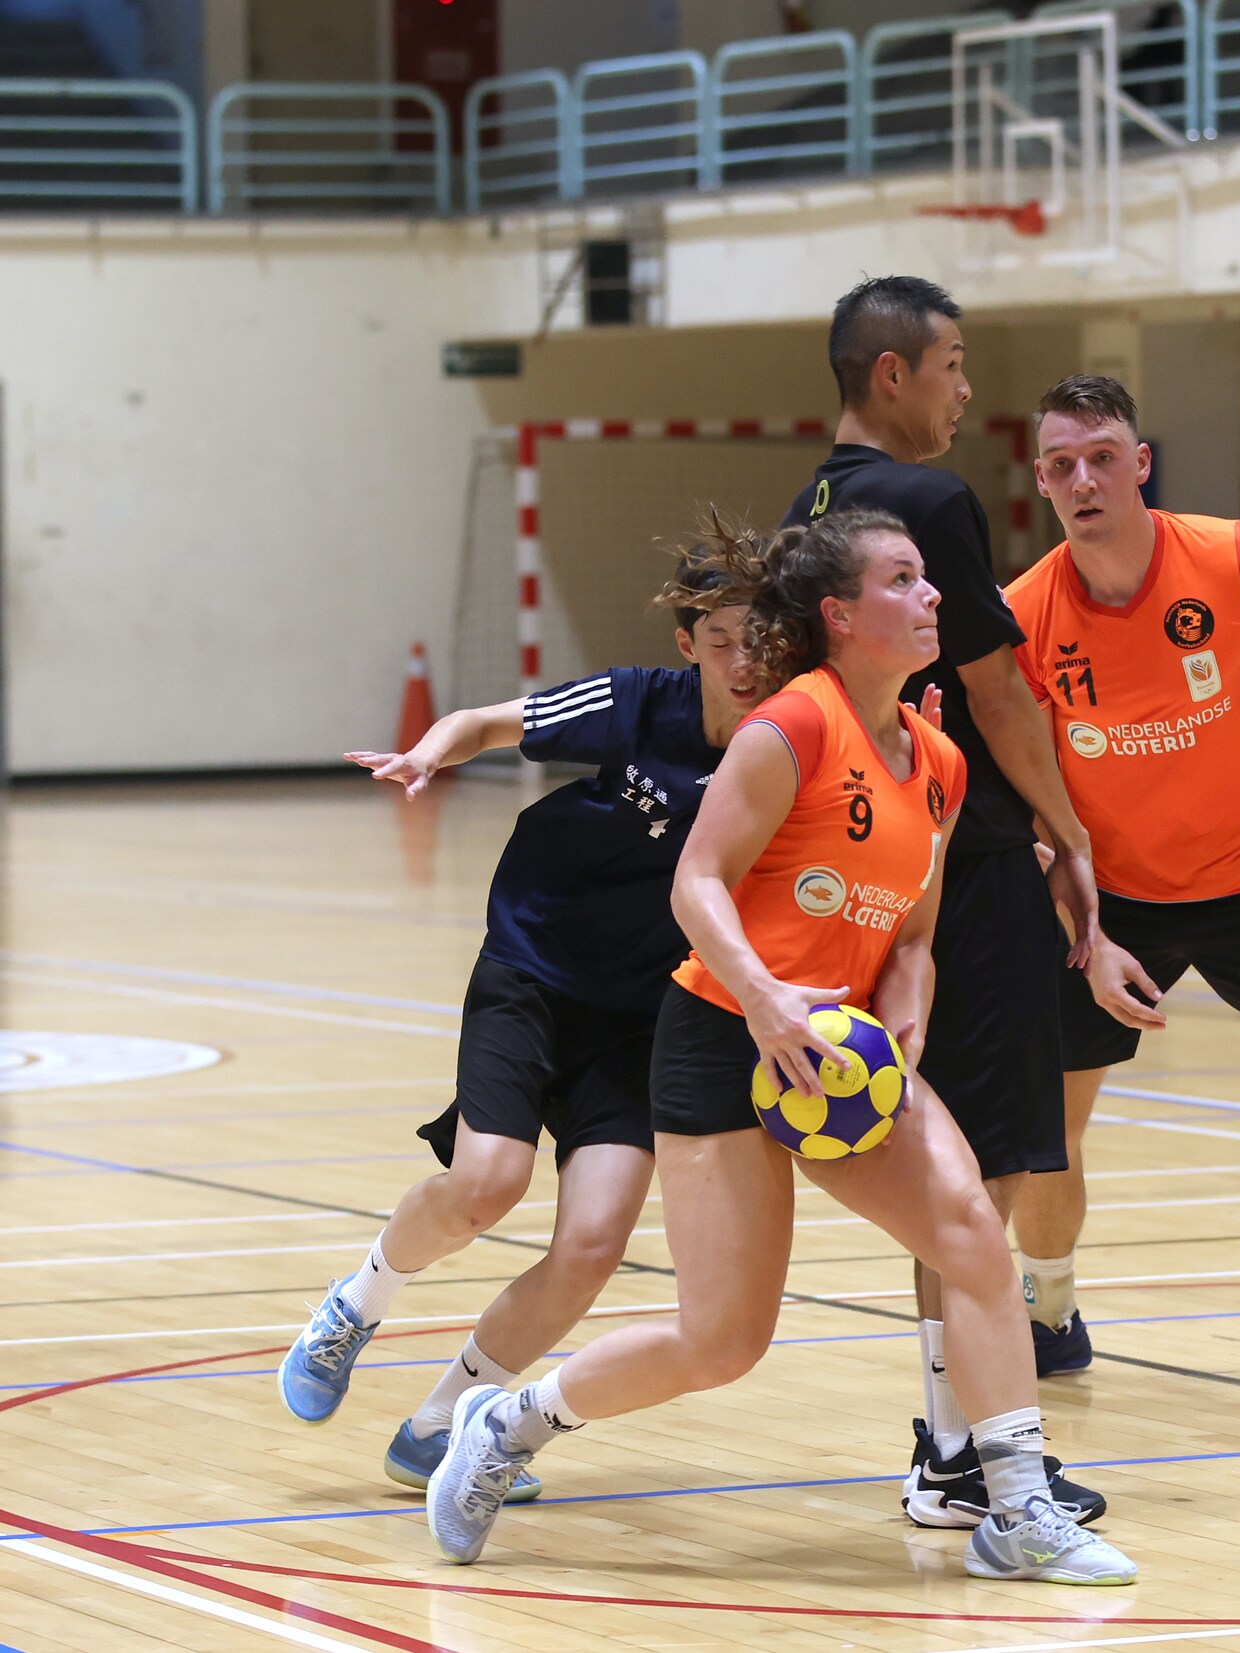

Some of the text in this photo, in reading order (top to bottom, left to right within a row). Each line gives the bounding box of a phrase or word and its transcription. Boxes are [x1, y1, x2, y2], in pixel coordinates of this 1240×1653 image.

[1054, 657, 1091, 670] erima
[1055, 667, 1098, 707] 11
[1107, 696, 1232, 739] NEDERLANDSE
[1111, 731, 1197, 756] LOTERIJ
[621, 787, 656, 814] 工程
[843, 782, 873, 796] erima
[847, 794, 873, 842] 9
